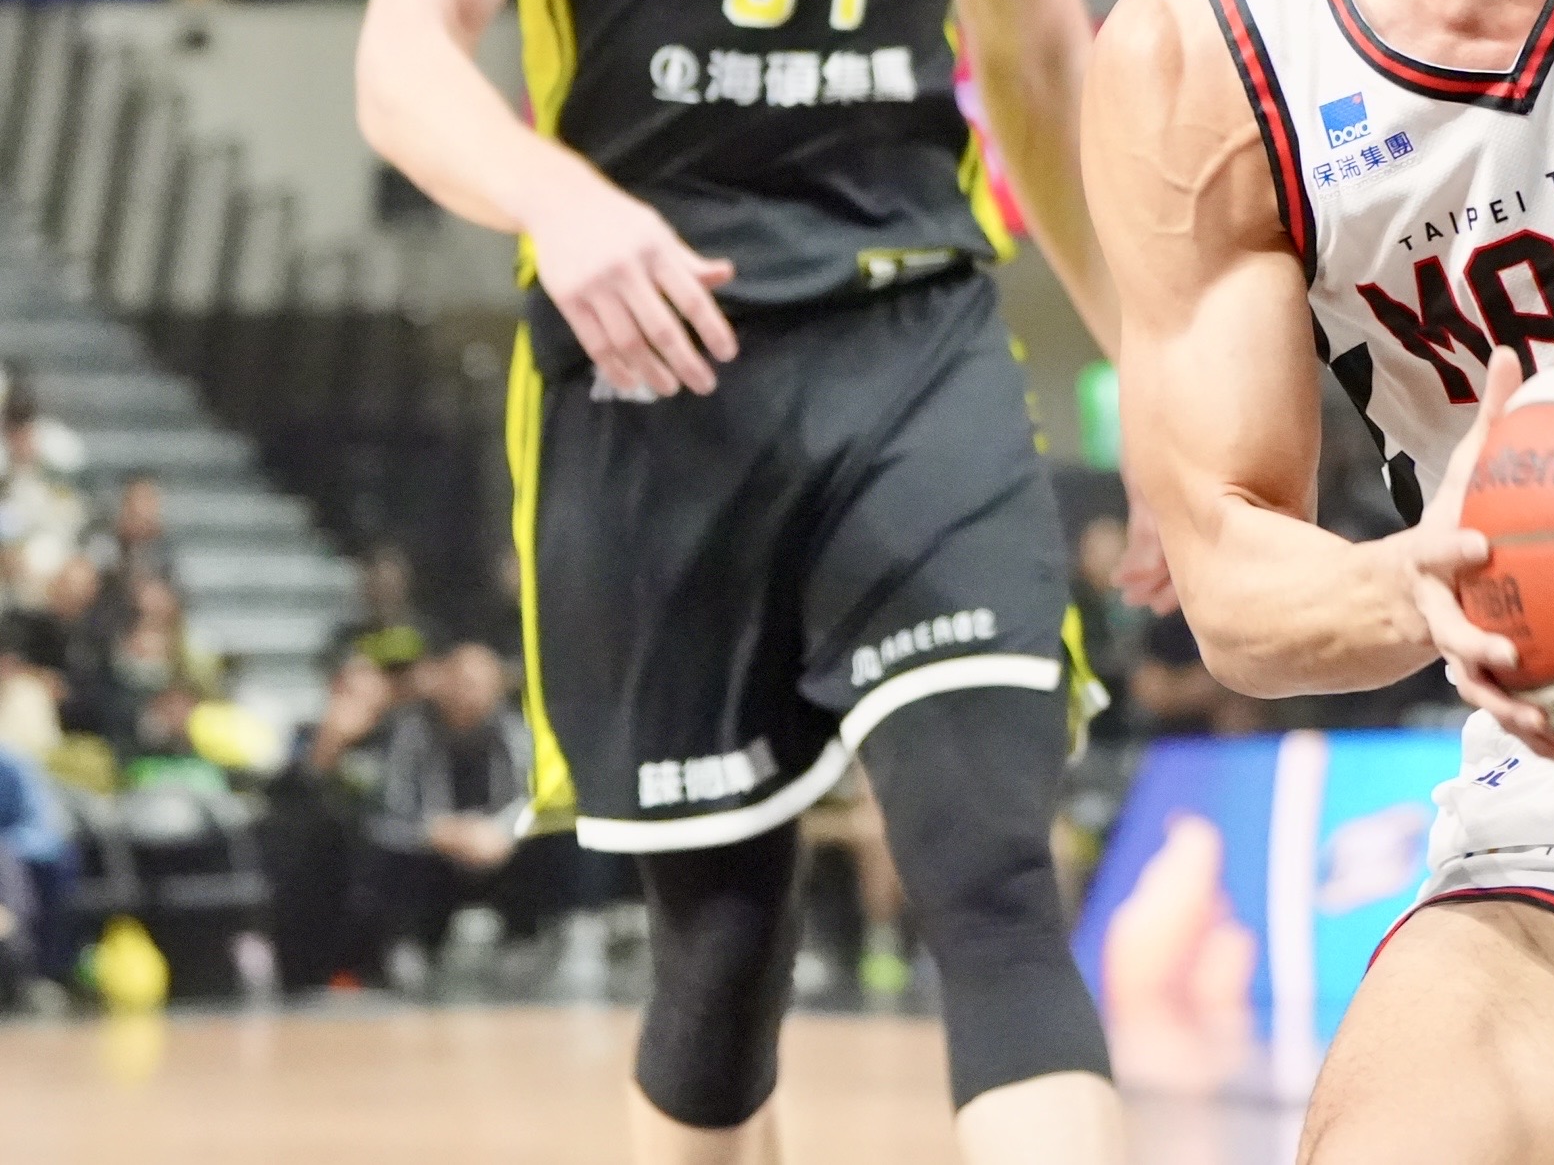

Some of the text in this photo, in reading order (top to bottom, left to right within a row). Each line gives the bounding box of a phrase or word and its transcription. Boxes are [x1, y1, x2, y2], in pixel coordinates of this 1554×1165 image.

[1312, 131, 1414, 190] 保瑞集團
[1398, 190, 1526, 251] TAIPEI
